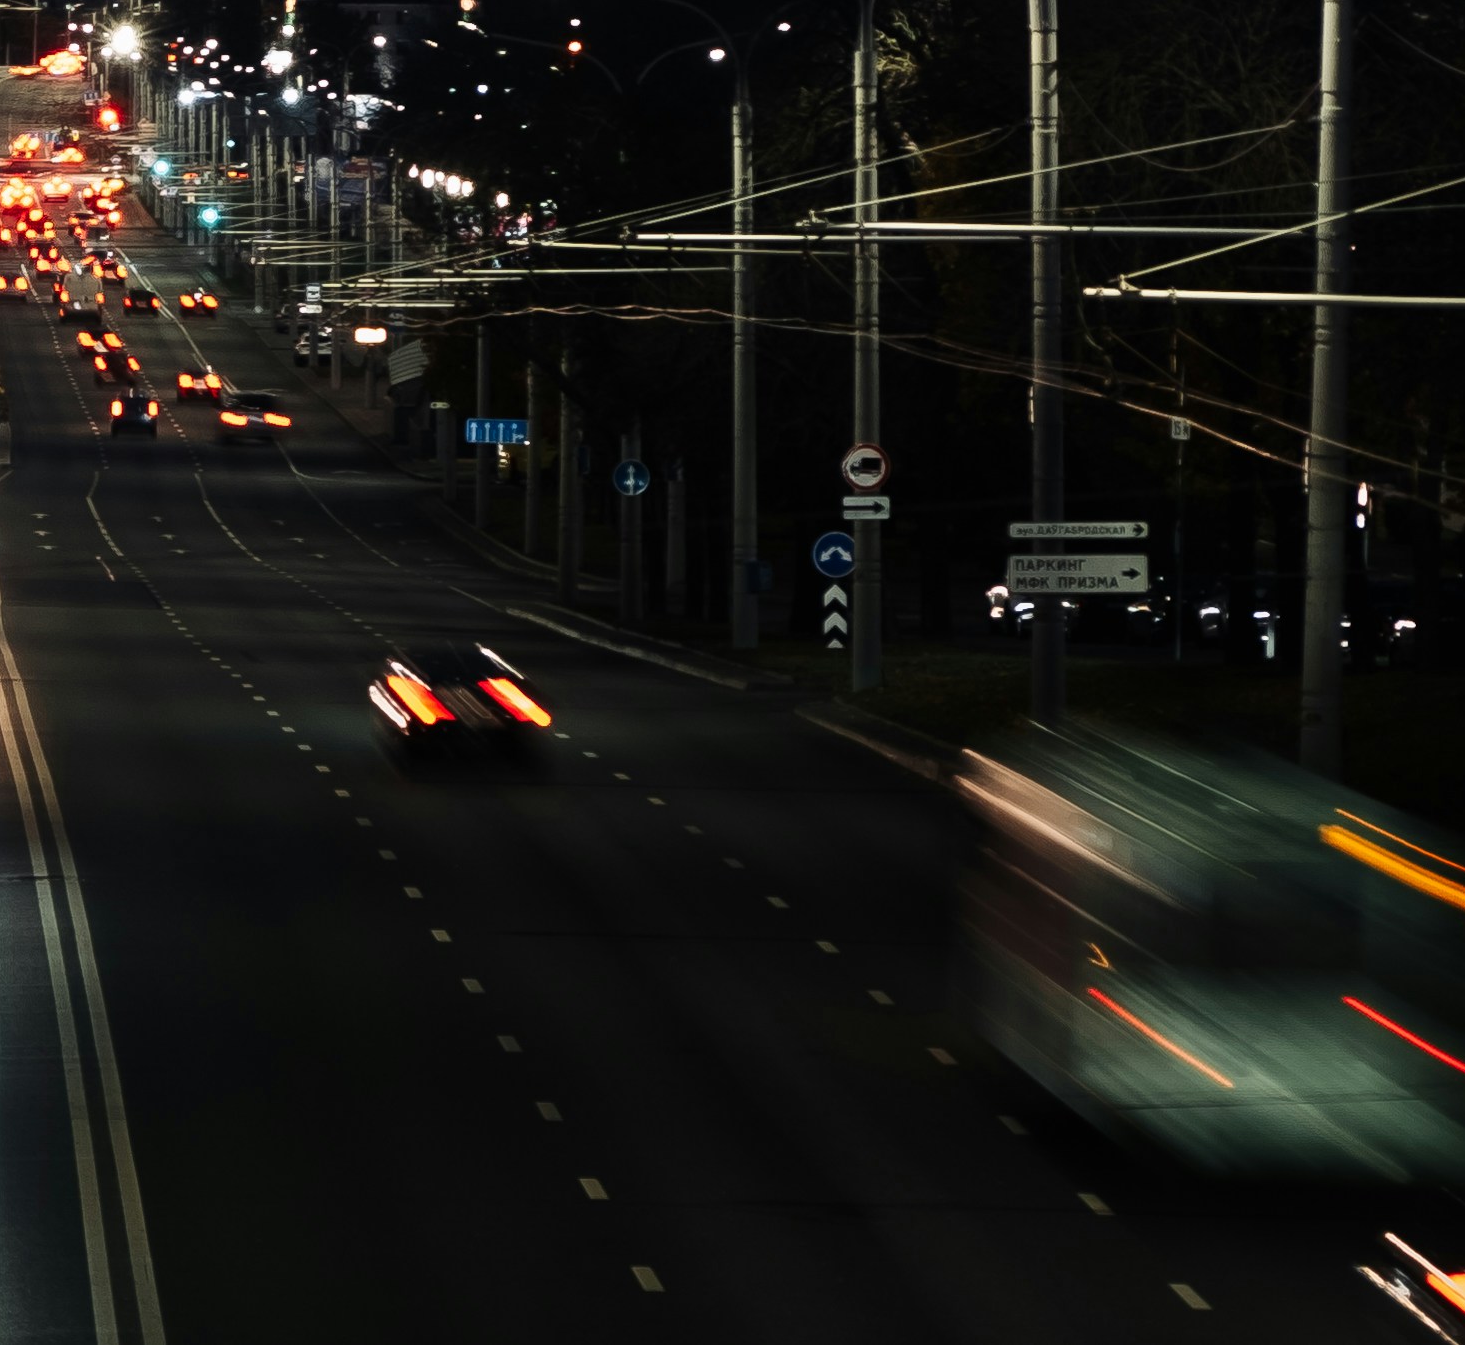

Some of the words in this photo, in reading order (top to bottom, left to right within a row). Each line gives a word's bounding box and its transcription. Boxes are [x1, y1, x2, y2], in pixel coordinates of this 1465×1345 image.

[1015, 558, 1086, 572] ПАРКИНГ
[1016, 575, 1050, 589] МФК
[1057, 575, 1119, 589] ПРИЗМА
